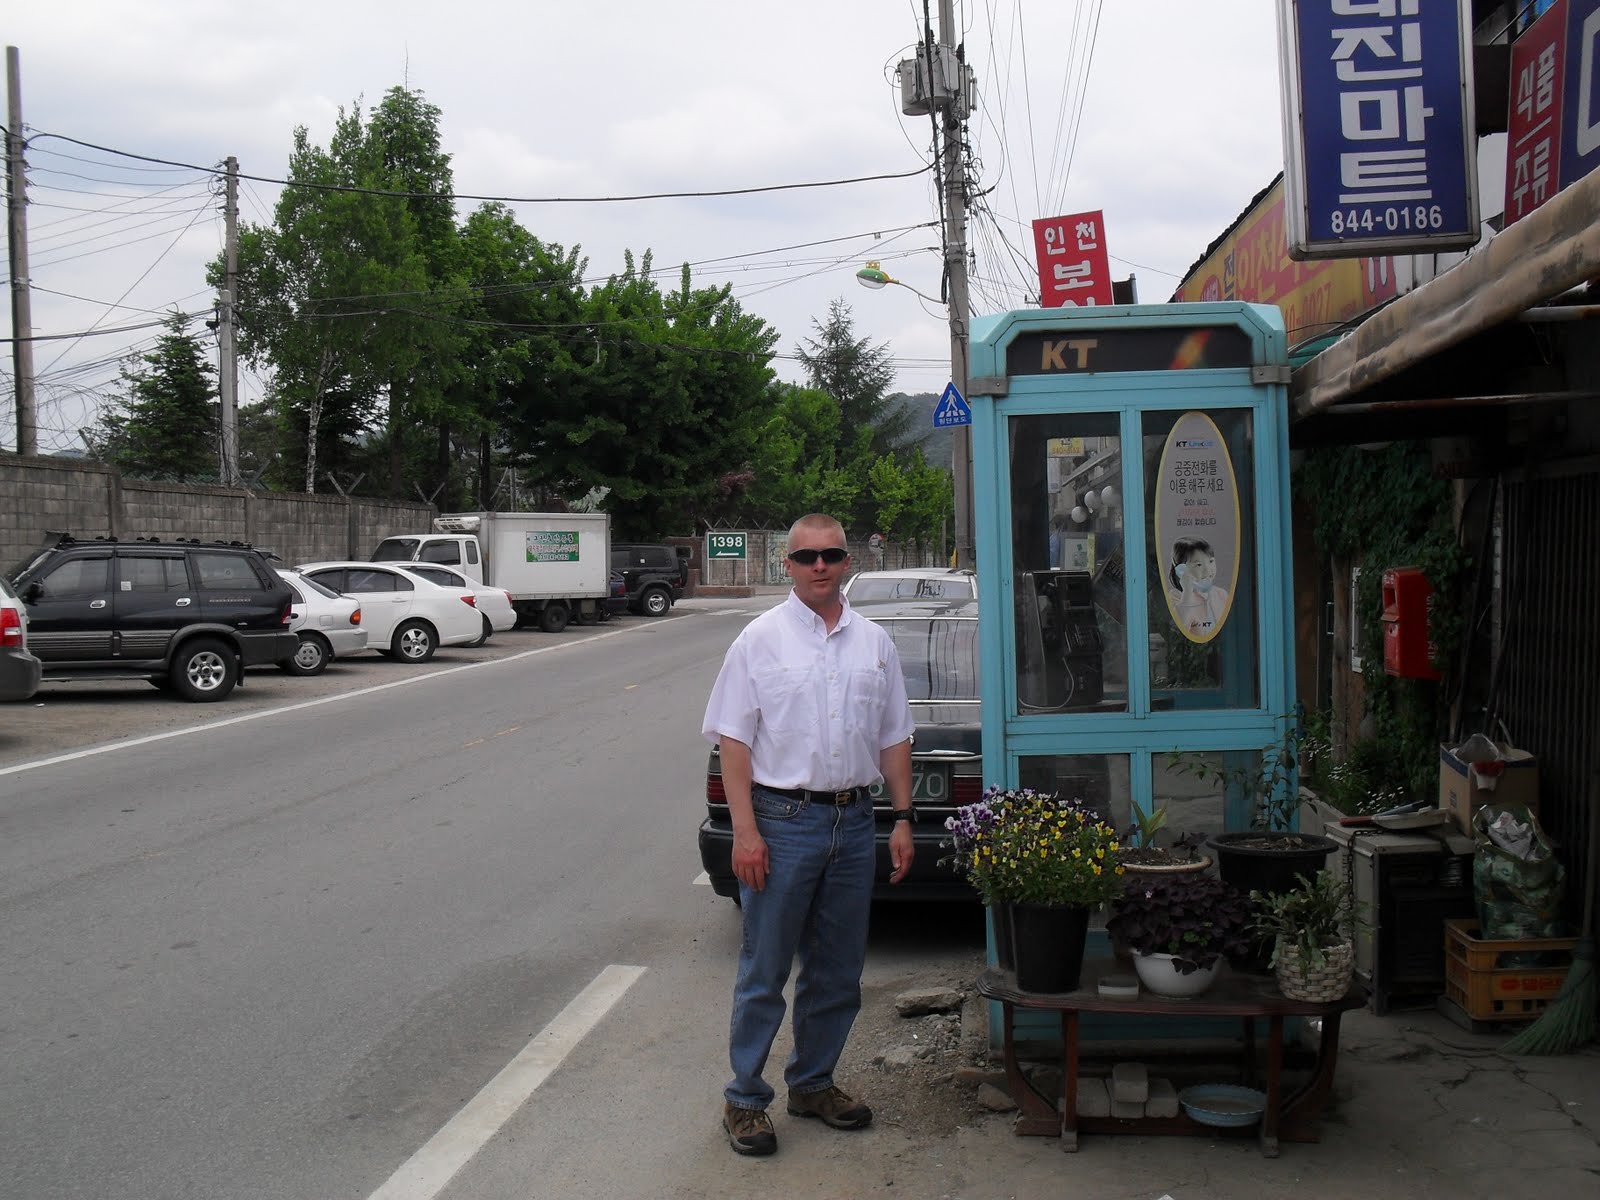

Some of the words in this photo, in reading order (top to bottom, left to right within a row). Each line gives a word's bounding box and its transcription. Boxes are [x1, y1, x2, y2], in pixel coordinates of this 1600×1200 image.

[1517, 43, 1555, 122] 식품
[1512, 136, 1550, 216] 주류
[1331, 205, 1443, 234] 844-0186
[1045, 221, 1097, 255] 인천
[1053, 260, 1096, 306] 보
[1041, 338, 1098, 370] KT
[1174, 460, 1217, 477] 공중전화를
[711, 536, 743, 547] 1398
